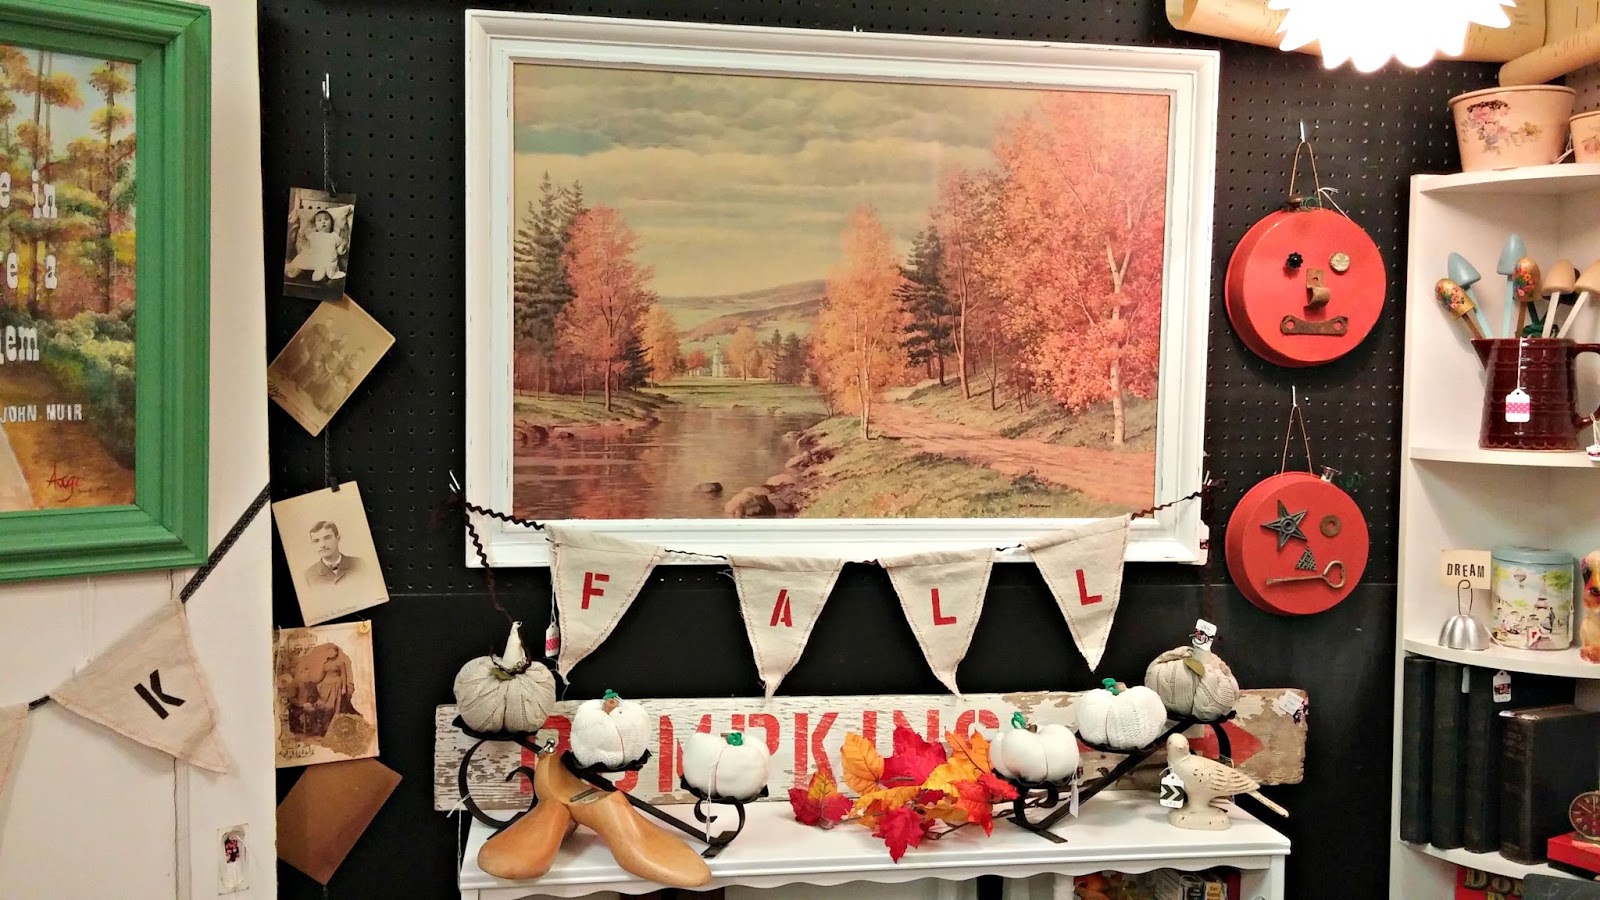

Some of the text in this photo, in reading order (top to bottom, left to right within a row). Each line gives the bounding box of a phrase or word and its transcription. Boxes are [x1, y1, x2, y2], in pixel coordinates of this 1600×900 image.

[31, 169, 58, 219] in
[45, 254, 58, 290] a
[0, 403, 83, 424] JOHN MUIR
[1446, 563, 1485, 578] DREAM
[133, 669, 186, 720] K
